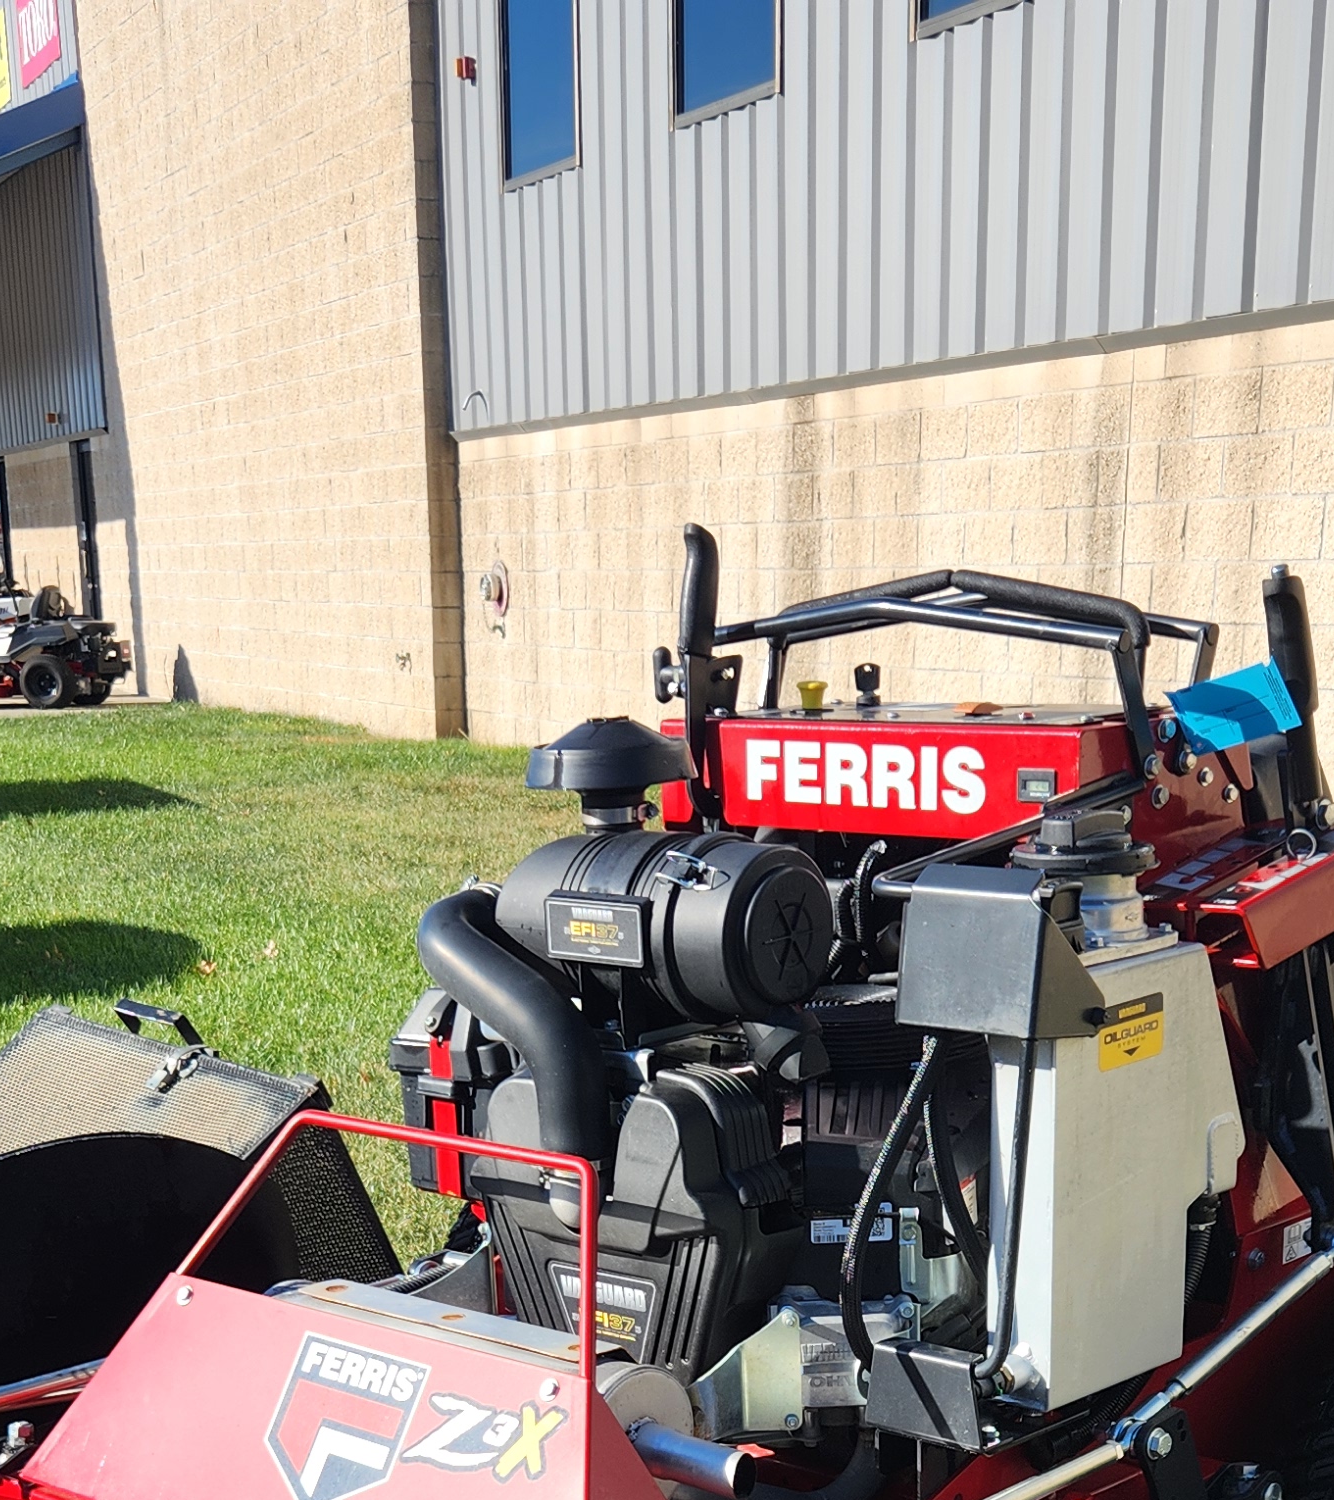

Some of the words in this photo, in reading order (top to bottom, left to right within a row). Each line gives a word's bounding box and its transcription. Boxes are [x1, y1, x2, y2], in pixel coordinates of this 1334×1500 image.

[746, 739, 986, 815] FERRIS
[1104, 1020, 1158, 1045] OILGUARD
[560, 1274, 647, 1312] VAGUARD
[301, 1341, 418, 1402] FERRIS
